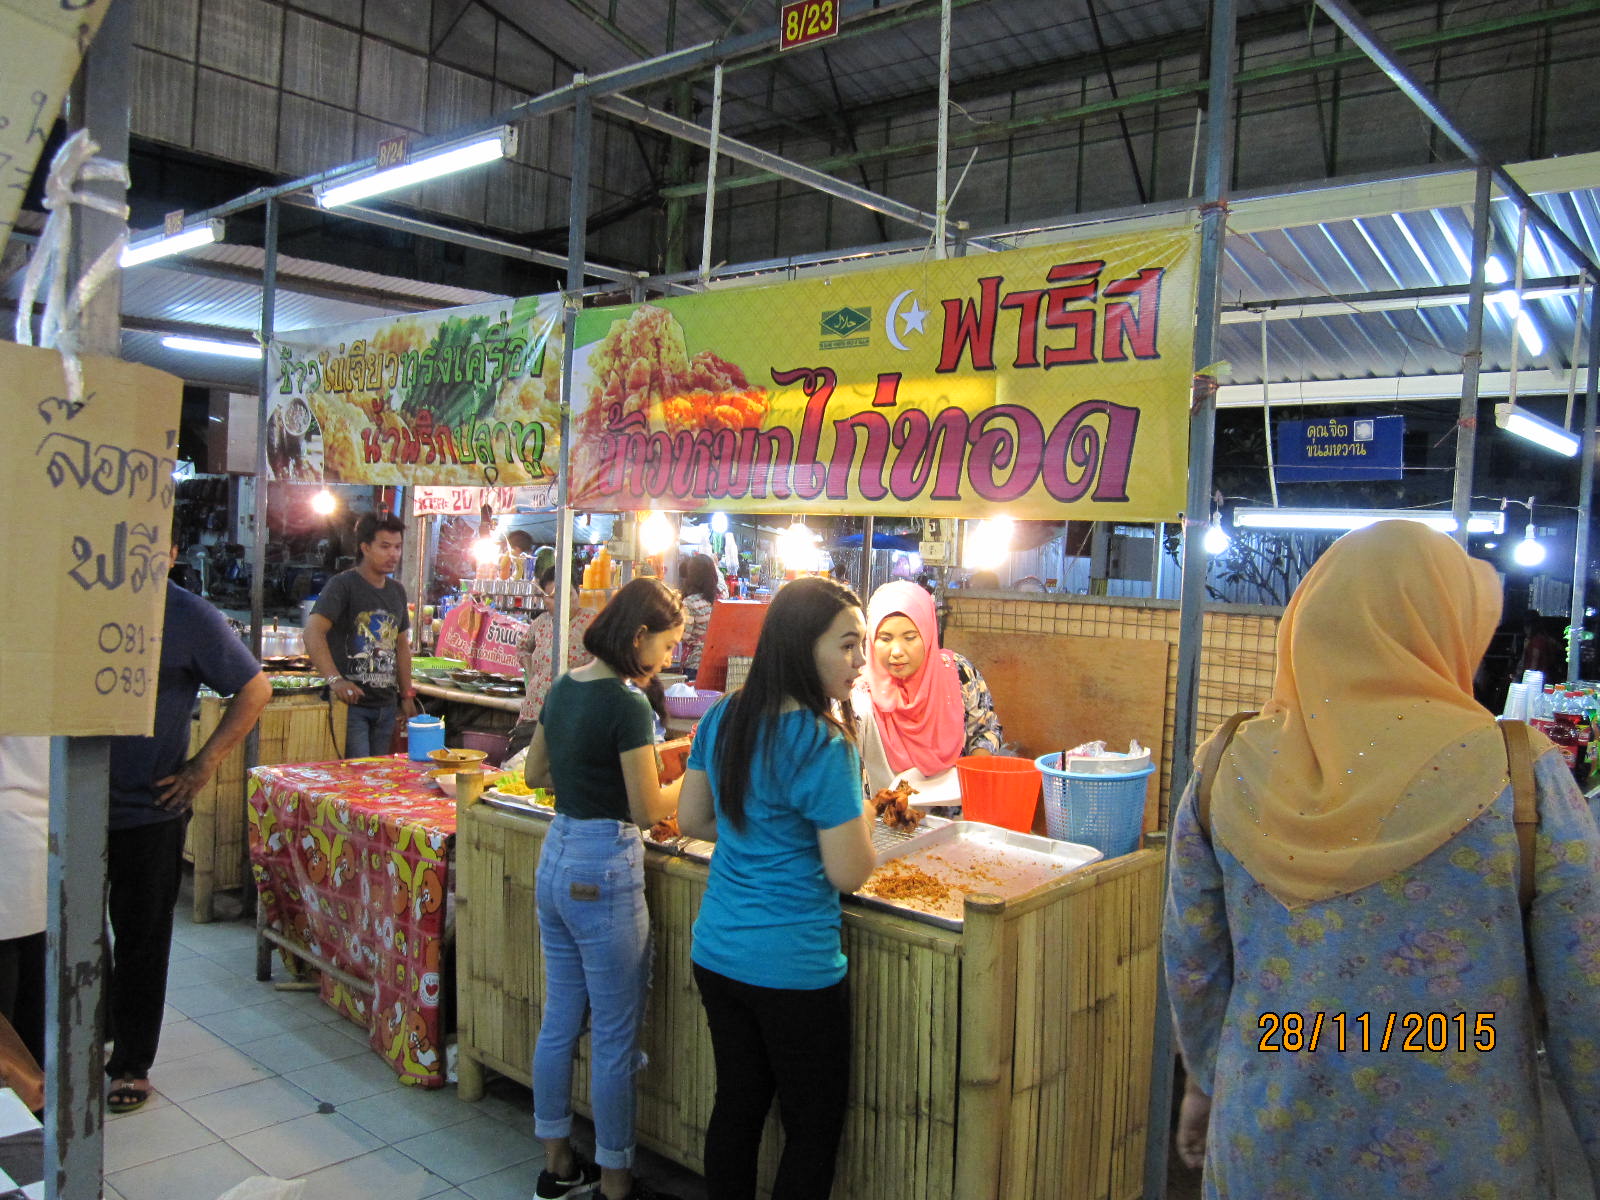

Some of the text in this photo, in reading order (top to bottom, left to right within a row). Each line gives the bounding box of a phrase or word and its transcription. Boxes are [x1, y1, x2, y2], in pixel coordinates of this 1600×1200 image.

[786, 1, 833, 41] 8/23
[380, 139, 404, 166] 8/24
[1306, 443, 1367, 457] ขนมหวาน
